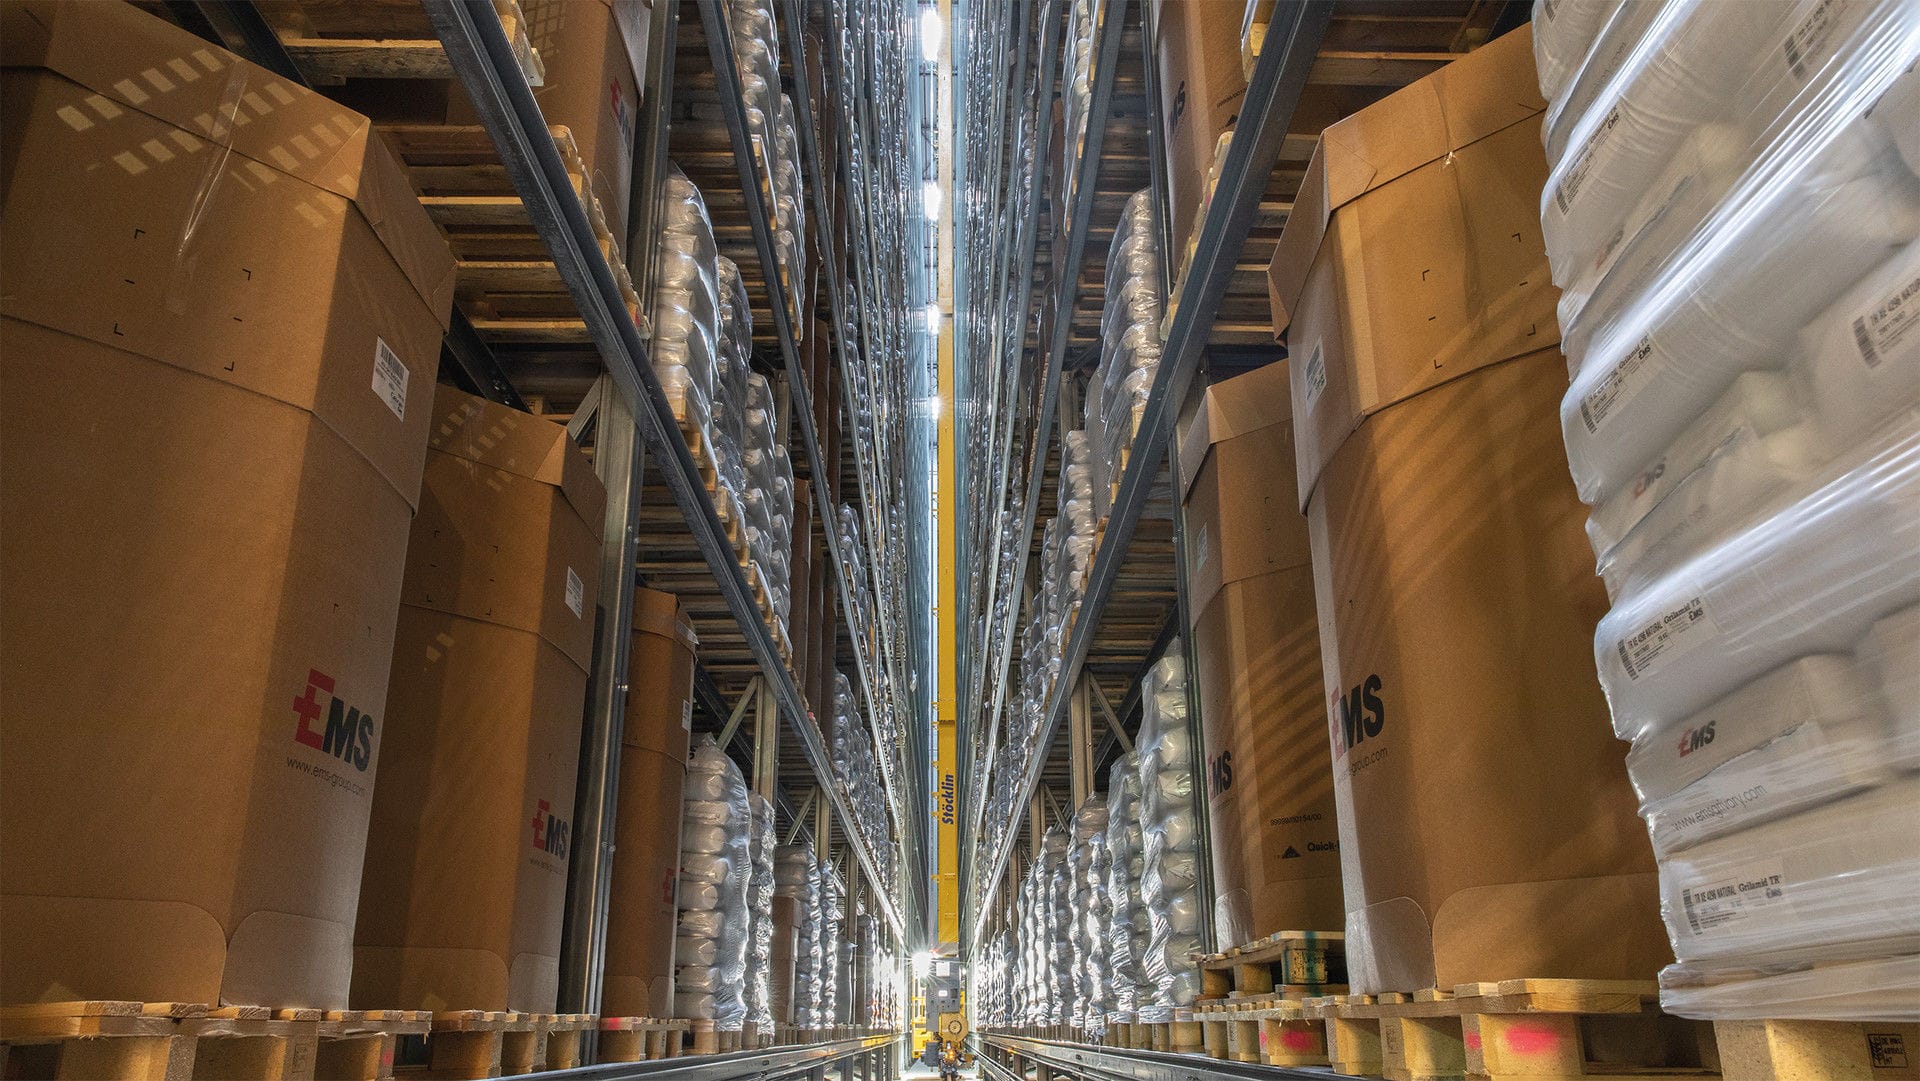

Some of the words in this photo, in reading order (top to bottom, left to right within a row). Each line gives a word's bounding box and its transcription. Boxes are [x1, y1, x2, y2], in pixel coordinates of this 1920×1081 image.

[1663, 602, 1691, 624] Grilamid
[1688, 607, 1704, 621] EMS
[292, 668, 374, 772] EMS
[1331, 673, 1385, 761] EMS
[1678, 720, 1716, 758] EMS
[941, 774, 954, 825] Stöcklin
[532, 798, 568, 861] EMS
[1738, 877, 1768, 893] Grilamid
